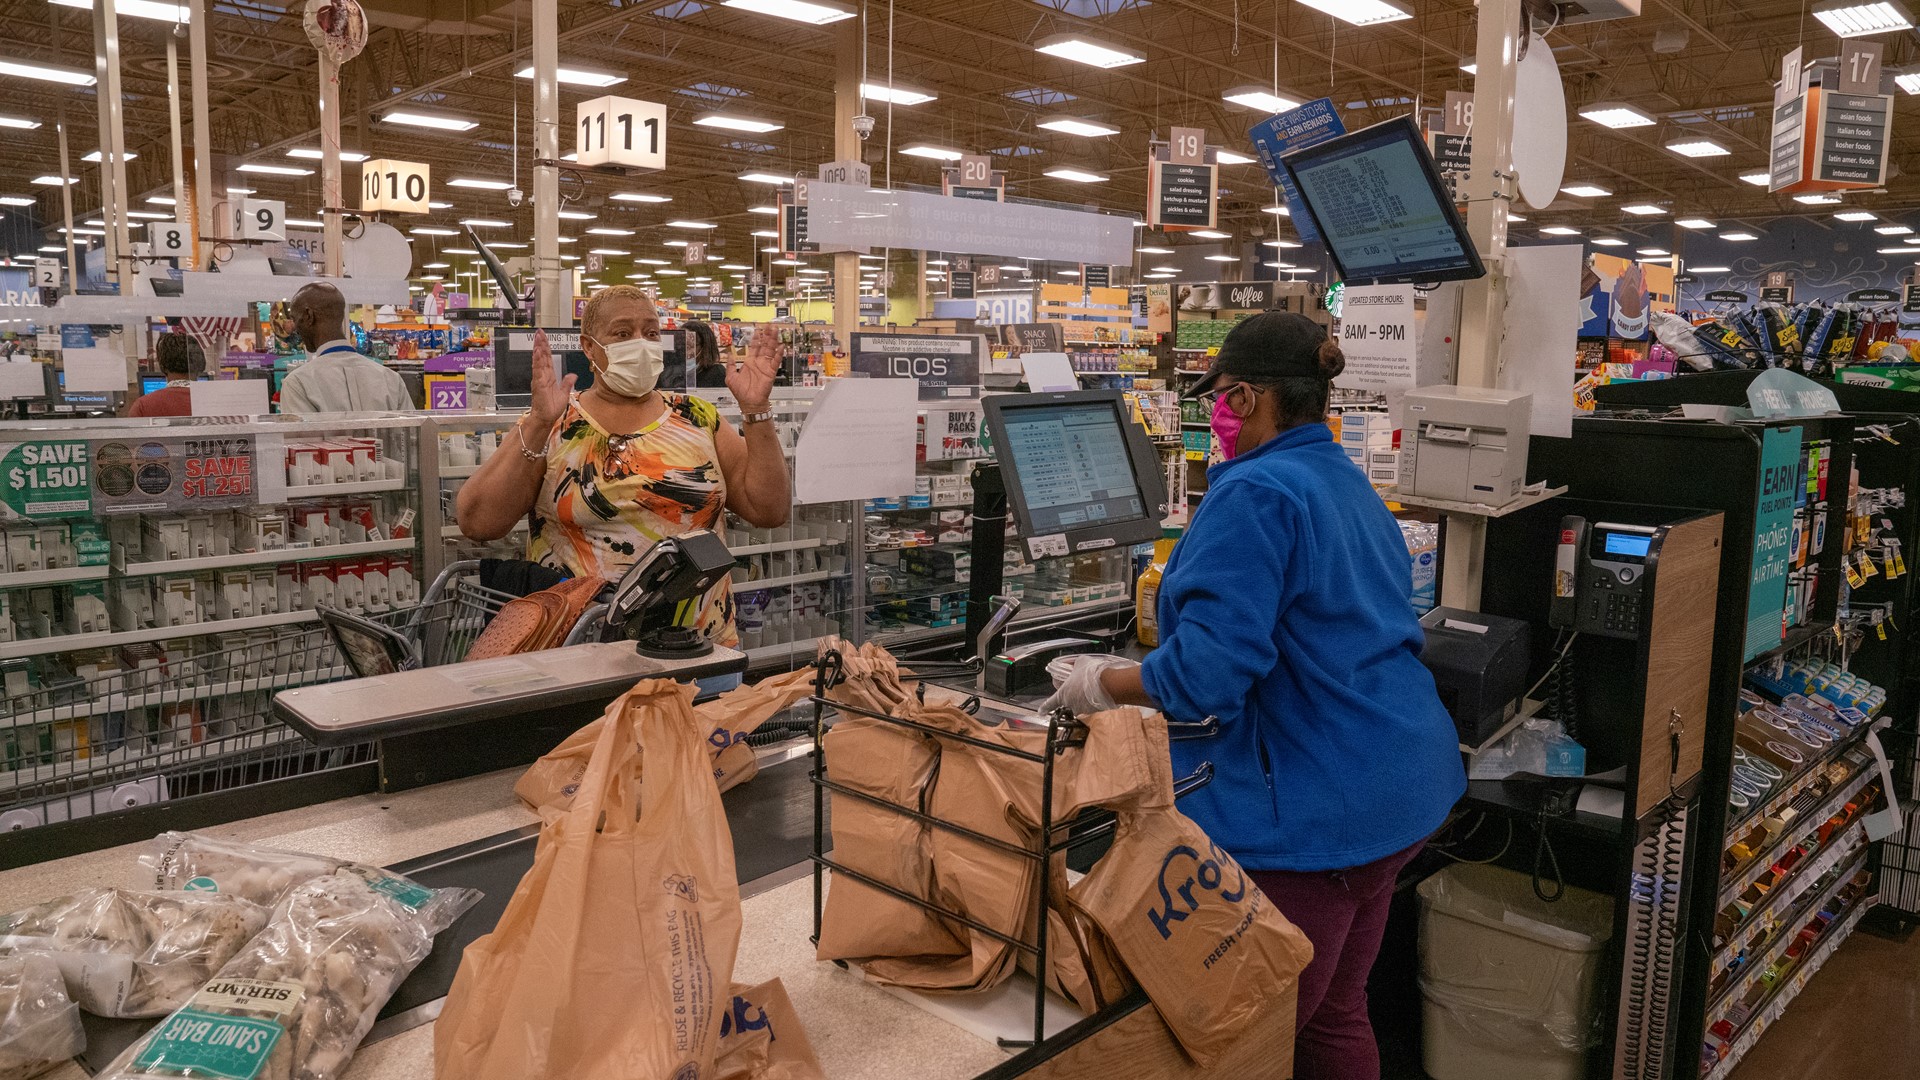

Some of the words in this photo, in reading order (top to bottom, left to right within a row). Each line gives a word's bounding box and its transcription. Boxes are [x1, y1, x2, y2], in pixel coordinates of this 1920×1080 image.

[1784, 58, 1798, 93] 17
[1850, 52, 1875, 83] 17
[1849, 99, 1866, 107] cereal
[1270, 115, 1289, 131] MORE
[1287, 110, 1306, 125] WAYS
[1304, 105, 1316, 119] TO
[1313, 100, 1329, 115] PAY
[1453, 101, 1474, 126] 18
[1840, 113, 1855, 121] asian
[1856, 113, 1872, 122] foods
[581, 112, 605, 152] 11
[617, 113, 658, 154] 11
[1276, 131, 1288, 141] AND
[1287, 124, 1305, 137] EARN
[1303, 113, 1333, 130] REWARDS
[1837, 126, 1855, 135] italian
[1856, 127, 1872, 136] foods
[1178, 135, 1198, 157] 19
[1835, 141, 1854, 150] kosher
[1855, 142, 1871, 151] foods
[1829, 154, 1841, 162] latin
[1859, 156, 1875, 165] foods
[824, 167, 846, 183] INFO
[965, 161, 986, 181] 20
[1832, 169, 1868, 179] international
[364, 171, 380, 200] 10
[385, 171, 425, 201] 10
[235, 209, 241, 231] 9
[256, 208, 274, 231] 9
[166, 230, 181, 249] 8
[689, 246, 699, 261] 23
[1364, 246, 1380, 256] 0.00
[589, 256, 599, 270] 25
[957, 259, 969, 270] 24
[44, 272, 53, 283] 2
[984, 268, 995, 280] 23
[1771, 276, 1782, 285] 19
[1231, 286, 1264, 307] Coffee
[1349, 296, 1368, 304] UPDATED
[1385, 295, 1404, 303] HOURS:
[1024, 330, 1046, 338] SNACK
[1345, 324, 1366, 339] 8AM
[1379, 325, 1404, 340] 9PM
[1617, 318, 1629, 331] CANDY
[1028, 339, 1046, 347] NUTS
[888, 357, 948, 379] IQOS
[436, 391, 464, 408] 2X
[1577, 390, 1594, 406] VIB
[948, 412, 967, 421] BUY
[969, 412, 975, 421] 2
[948, 423, 975, 433] PACKS
[22, 444, 87, 465] SAVE
[184, 439, 231, 457] BUY
[237, 438, 250, 454] 2
[185, 456, 251, 477] SAVE
[9, 466, 87, 490] $1.50!
[182, 475, 251, 498] $1.25!
[1763, 463, 1795, 496] EARN
[1760, 500, 1773, 515] FUEL
[1774, 496, 1791, 511] POINTS
[263, 542, 283, 550] Marlboro
[1757, 527, 1787, 554] PHONES
[1753, 559, 1785, 585] AIRTIME
[1147, 840, 1245, 940] Krog
[668, 909, 678, 931] BAG
[671, 931, 681, 956] THIS
[1203, 936, 1236, 970] FRESH
[1236, 912, 1254, 939] FOR
[672, 958, 685, 1003] RECYCLE
[206, 983, 291, 1000] SHRIMP
[234, 997, 250, 1005] RAW
[674, 1005, 686, 1015] &
[166, 1018, 213, 1043] BAR
[208, 1025, 268, 1054] SAND
[675, 1015, 688, 1051] REUSE
